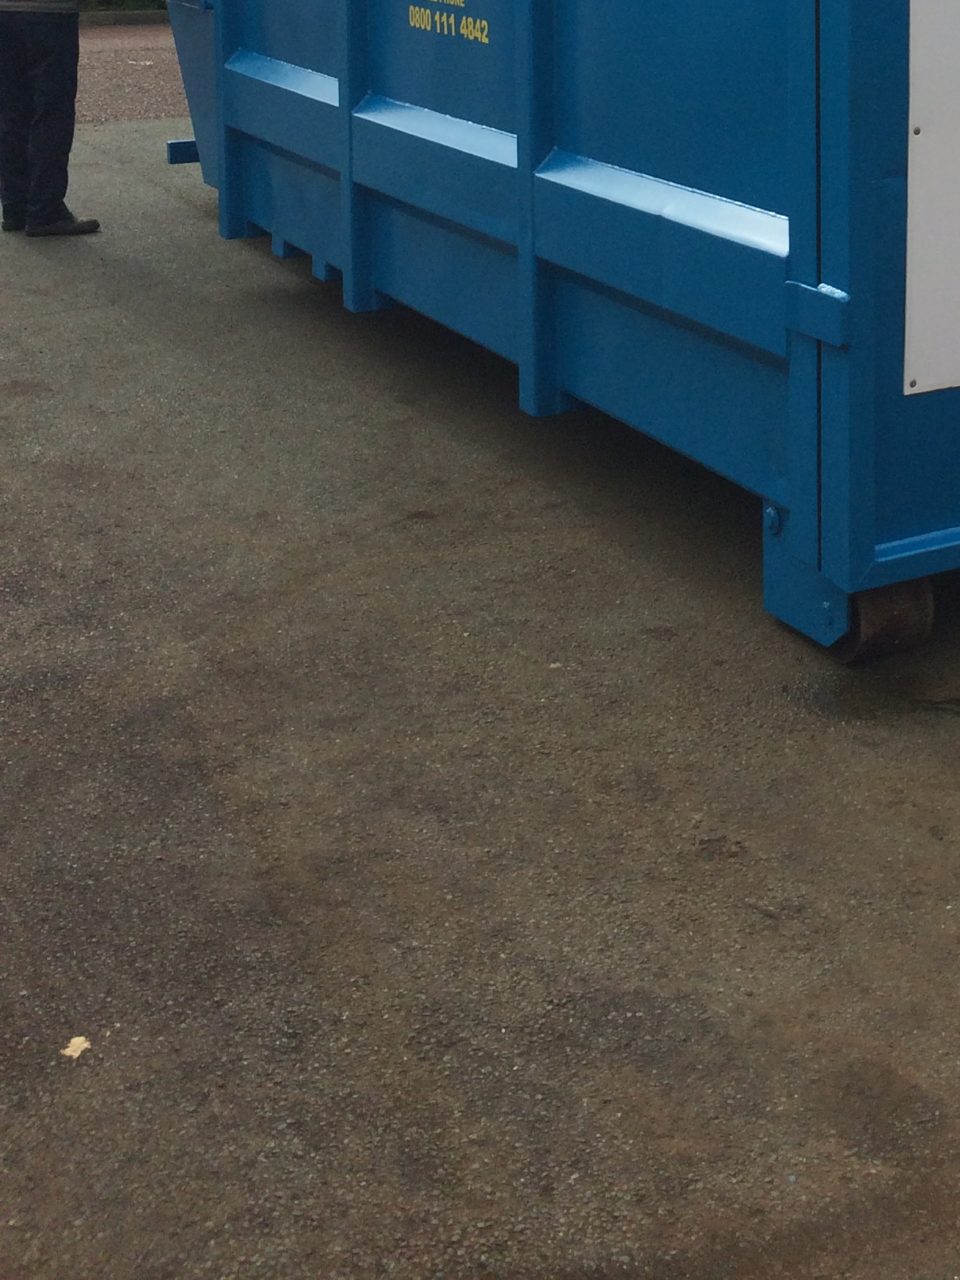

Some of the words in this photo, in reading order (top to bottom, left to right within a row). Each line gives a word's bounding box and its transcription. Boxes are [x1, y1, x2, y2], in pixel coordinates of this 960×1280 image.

[408, 5, 432, 31] 0800
[434, 11, 456, 36] 111
[459, 16, 489, 44] 4842
